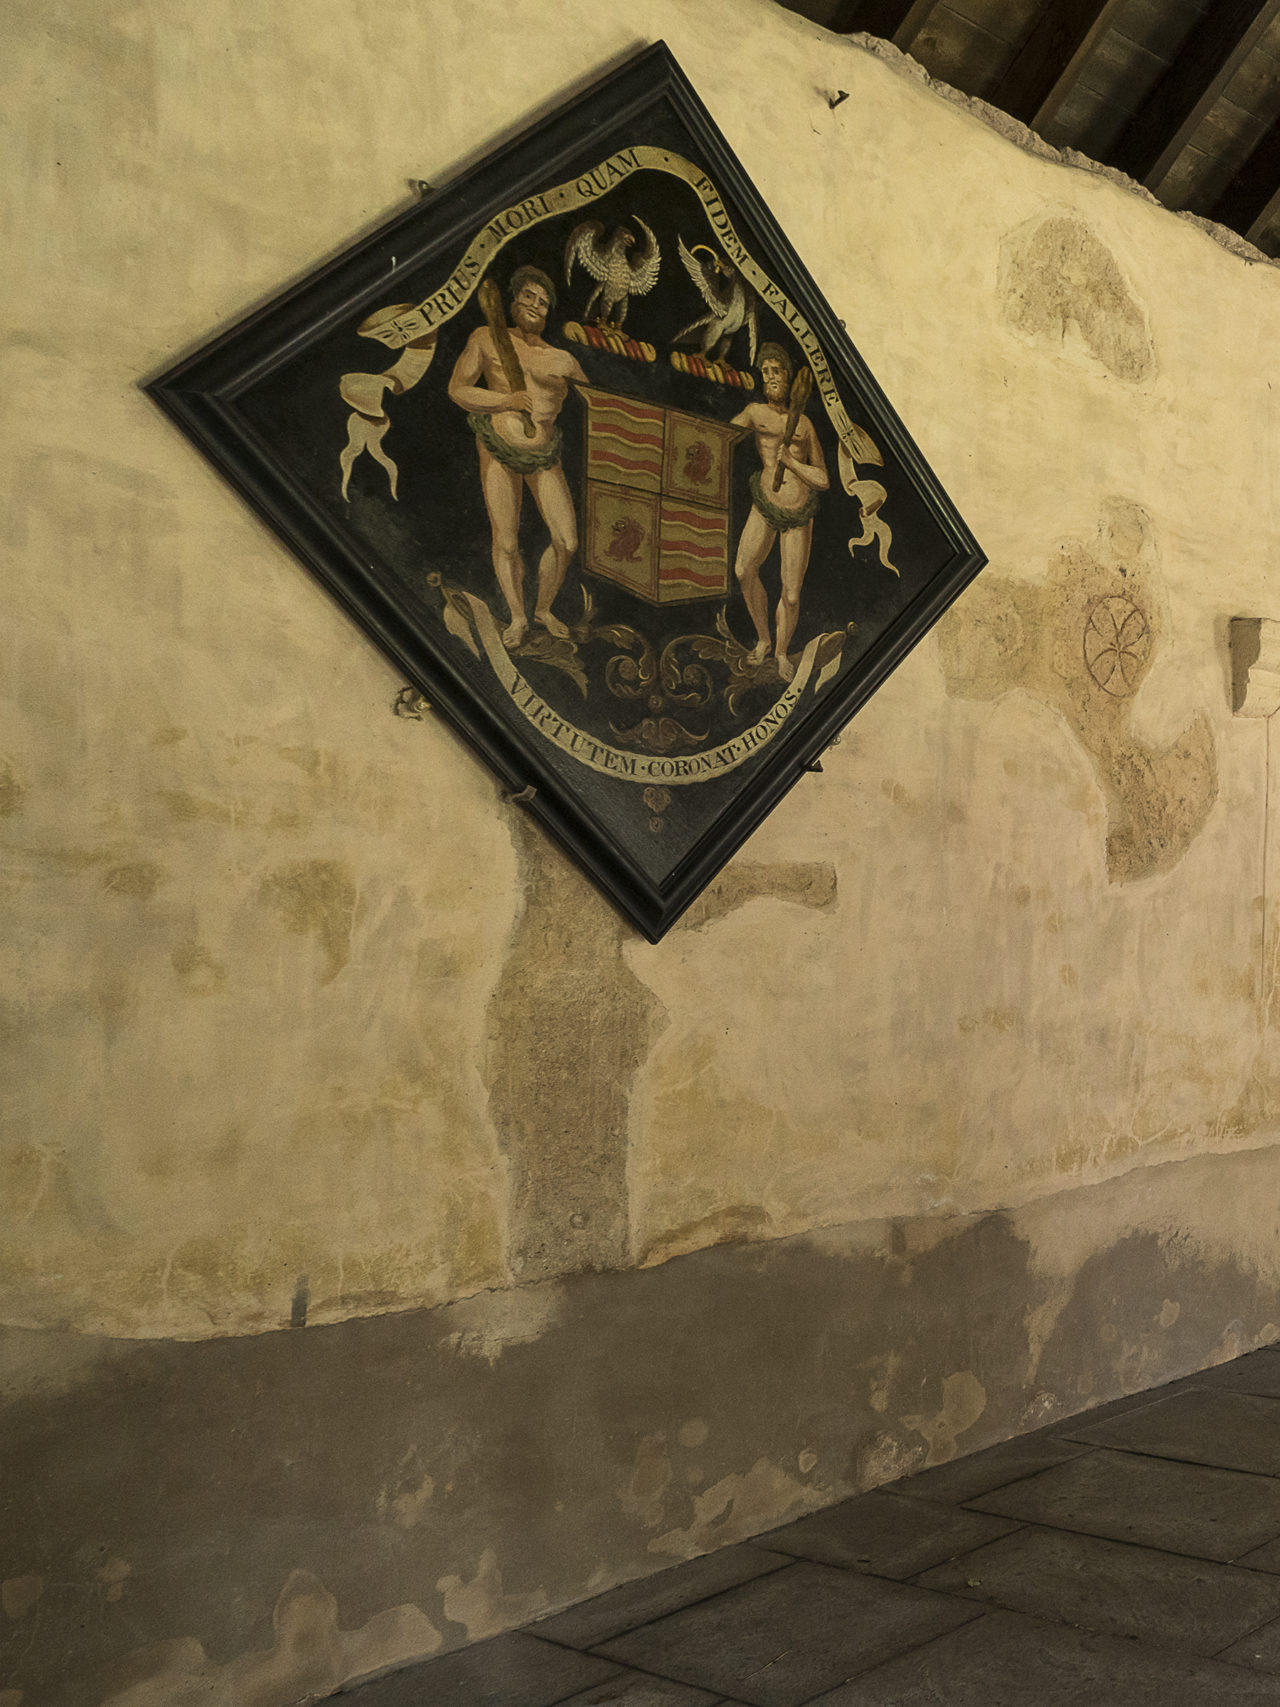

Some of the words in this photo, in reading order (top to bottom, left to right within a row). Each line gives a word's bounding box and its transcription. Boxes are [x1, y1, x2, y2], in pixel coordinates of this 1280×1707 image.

[416, 255, 480, 327] PRIUS
[486, 195, 553, 244] MORI
[576, 149, 643, 200] QUAM
[694, 175, 748, 268] FIDEM
[761, 280, 840, 408] FALLERE
[509, 671, 638, 775] VIRTUTEM
[647, 747, 737, 777] CORONAT
